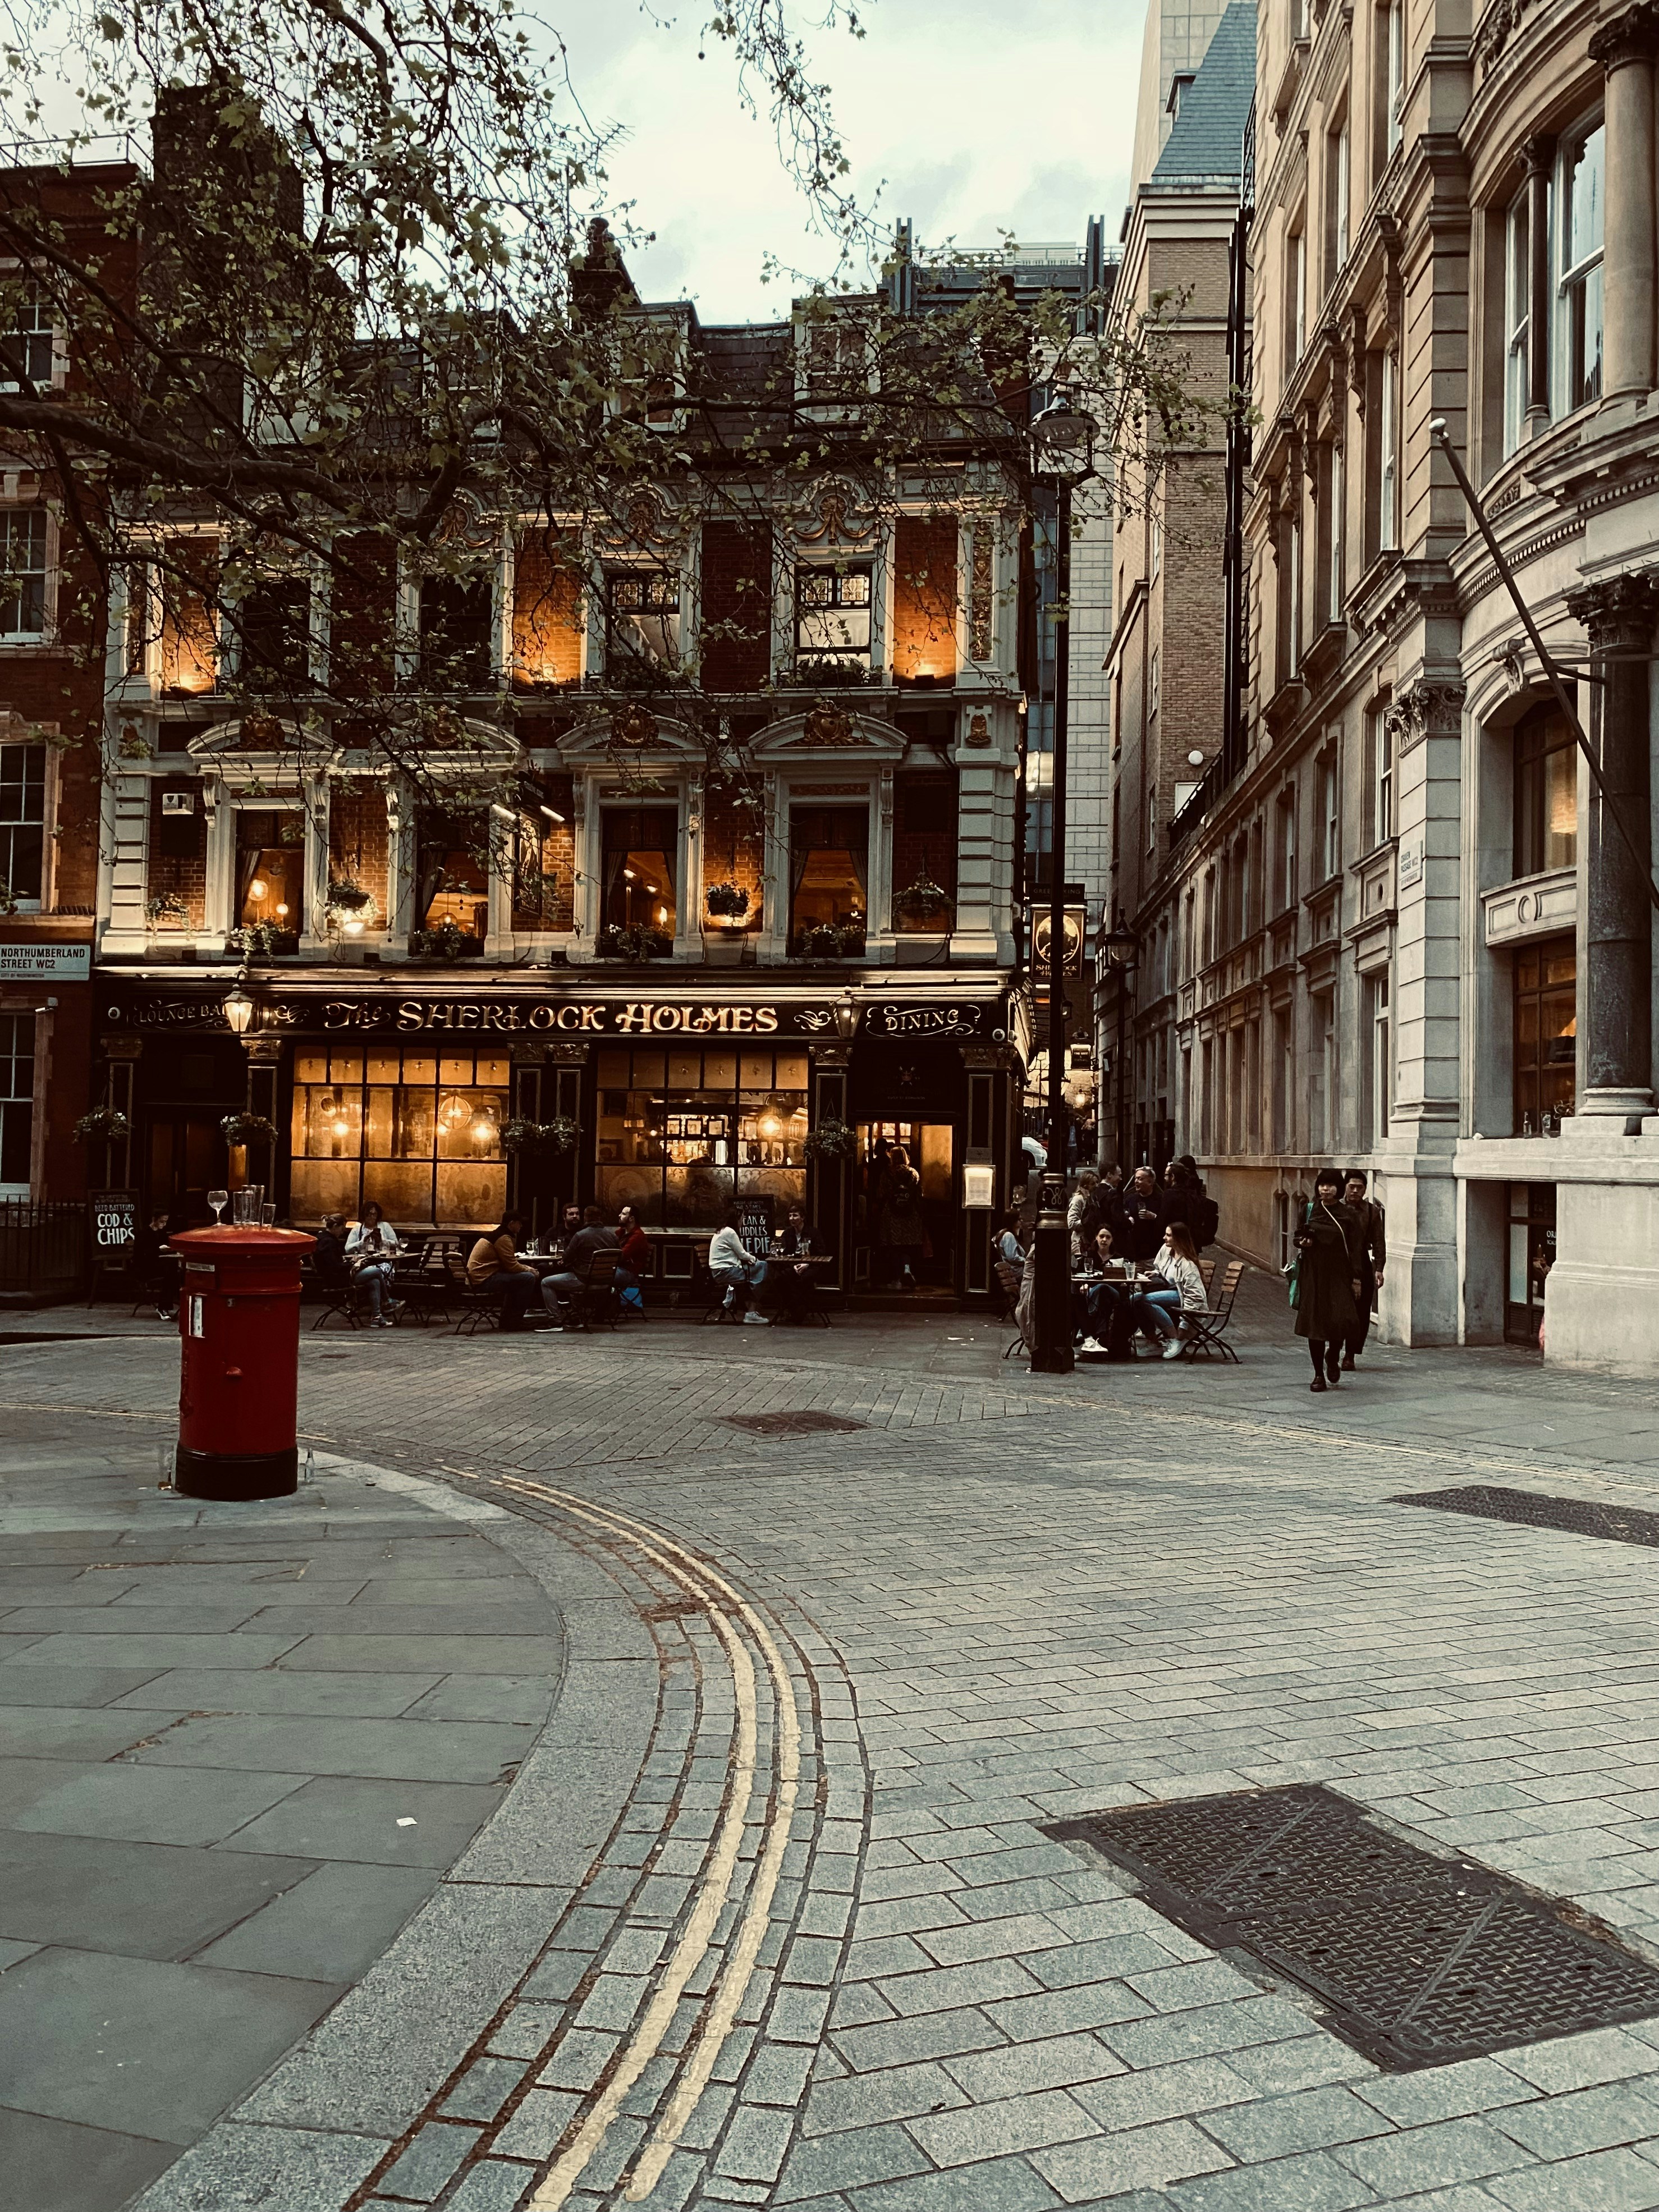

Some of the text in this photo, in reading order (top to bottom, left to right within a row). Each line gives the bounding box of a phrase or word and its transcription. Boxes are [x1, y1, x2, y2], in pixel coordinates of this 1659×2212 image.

[1, 948, 85, 958] NORTHUMBERLAND
[1, 959, 56, 968] STREET WC2
[139, 1004, 226, 1023] LOUNGE BA
[322, 1001, 778, 1033] The SHERLOCK HOLMES
[885, 1009, 959, 1031] DINING
[97, 1213, 133, 1228] COD &
[743, 1215, 766, 1225] EAK &
[97, 1227, 135, 1245] CHIPS
[739, 1226, 768, 1236] UDDLES
[754, 1236, 771, 1253] PIE
